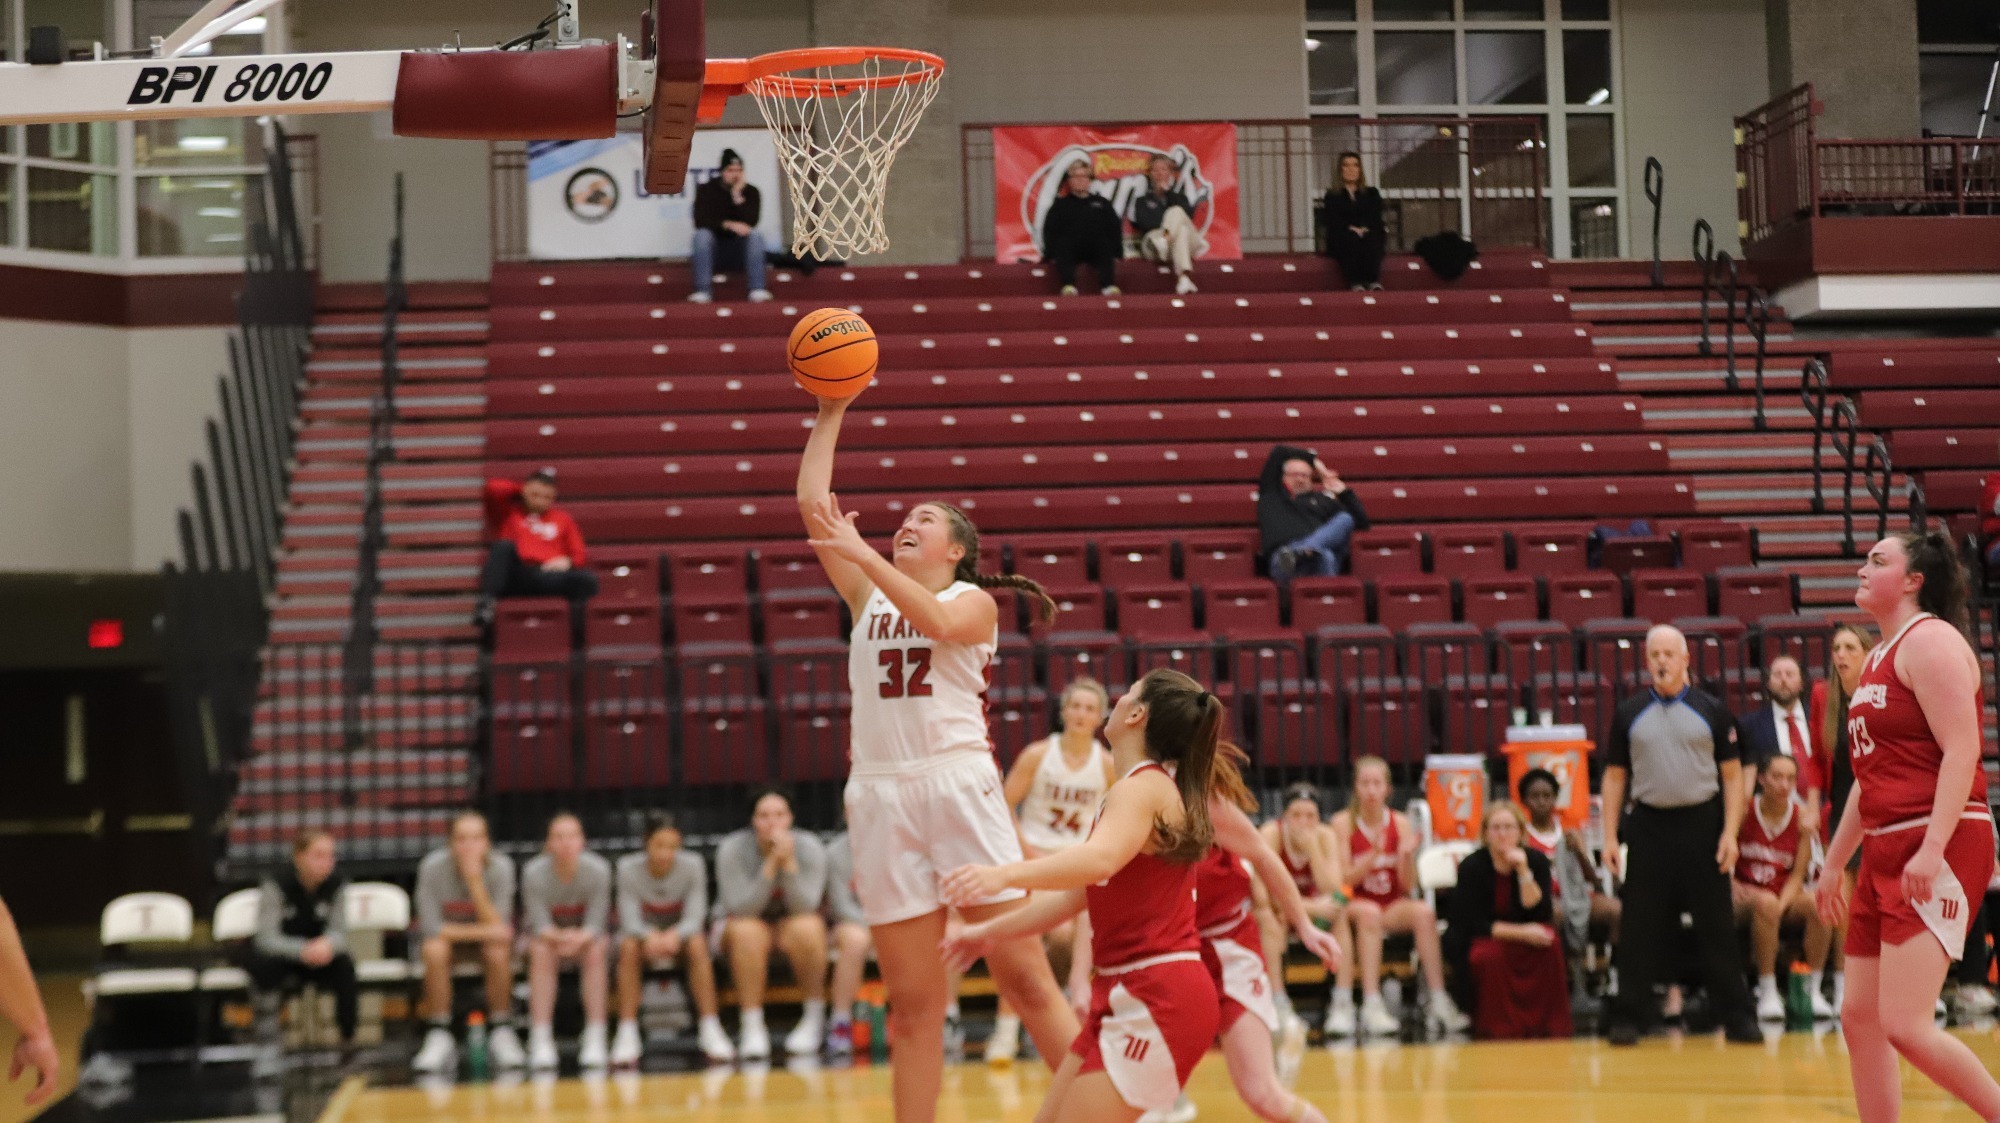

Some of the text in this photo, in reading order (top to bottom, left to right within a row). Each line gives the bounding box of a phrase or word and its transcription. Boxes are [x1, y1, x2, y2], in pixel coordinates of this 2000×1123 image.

[127, 62, 332, 105] BPI 8000
[811, 319, 867, 342] Wilson
[879, 647, 933, 698] 32
